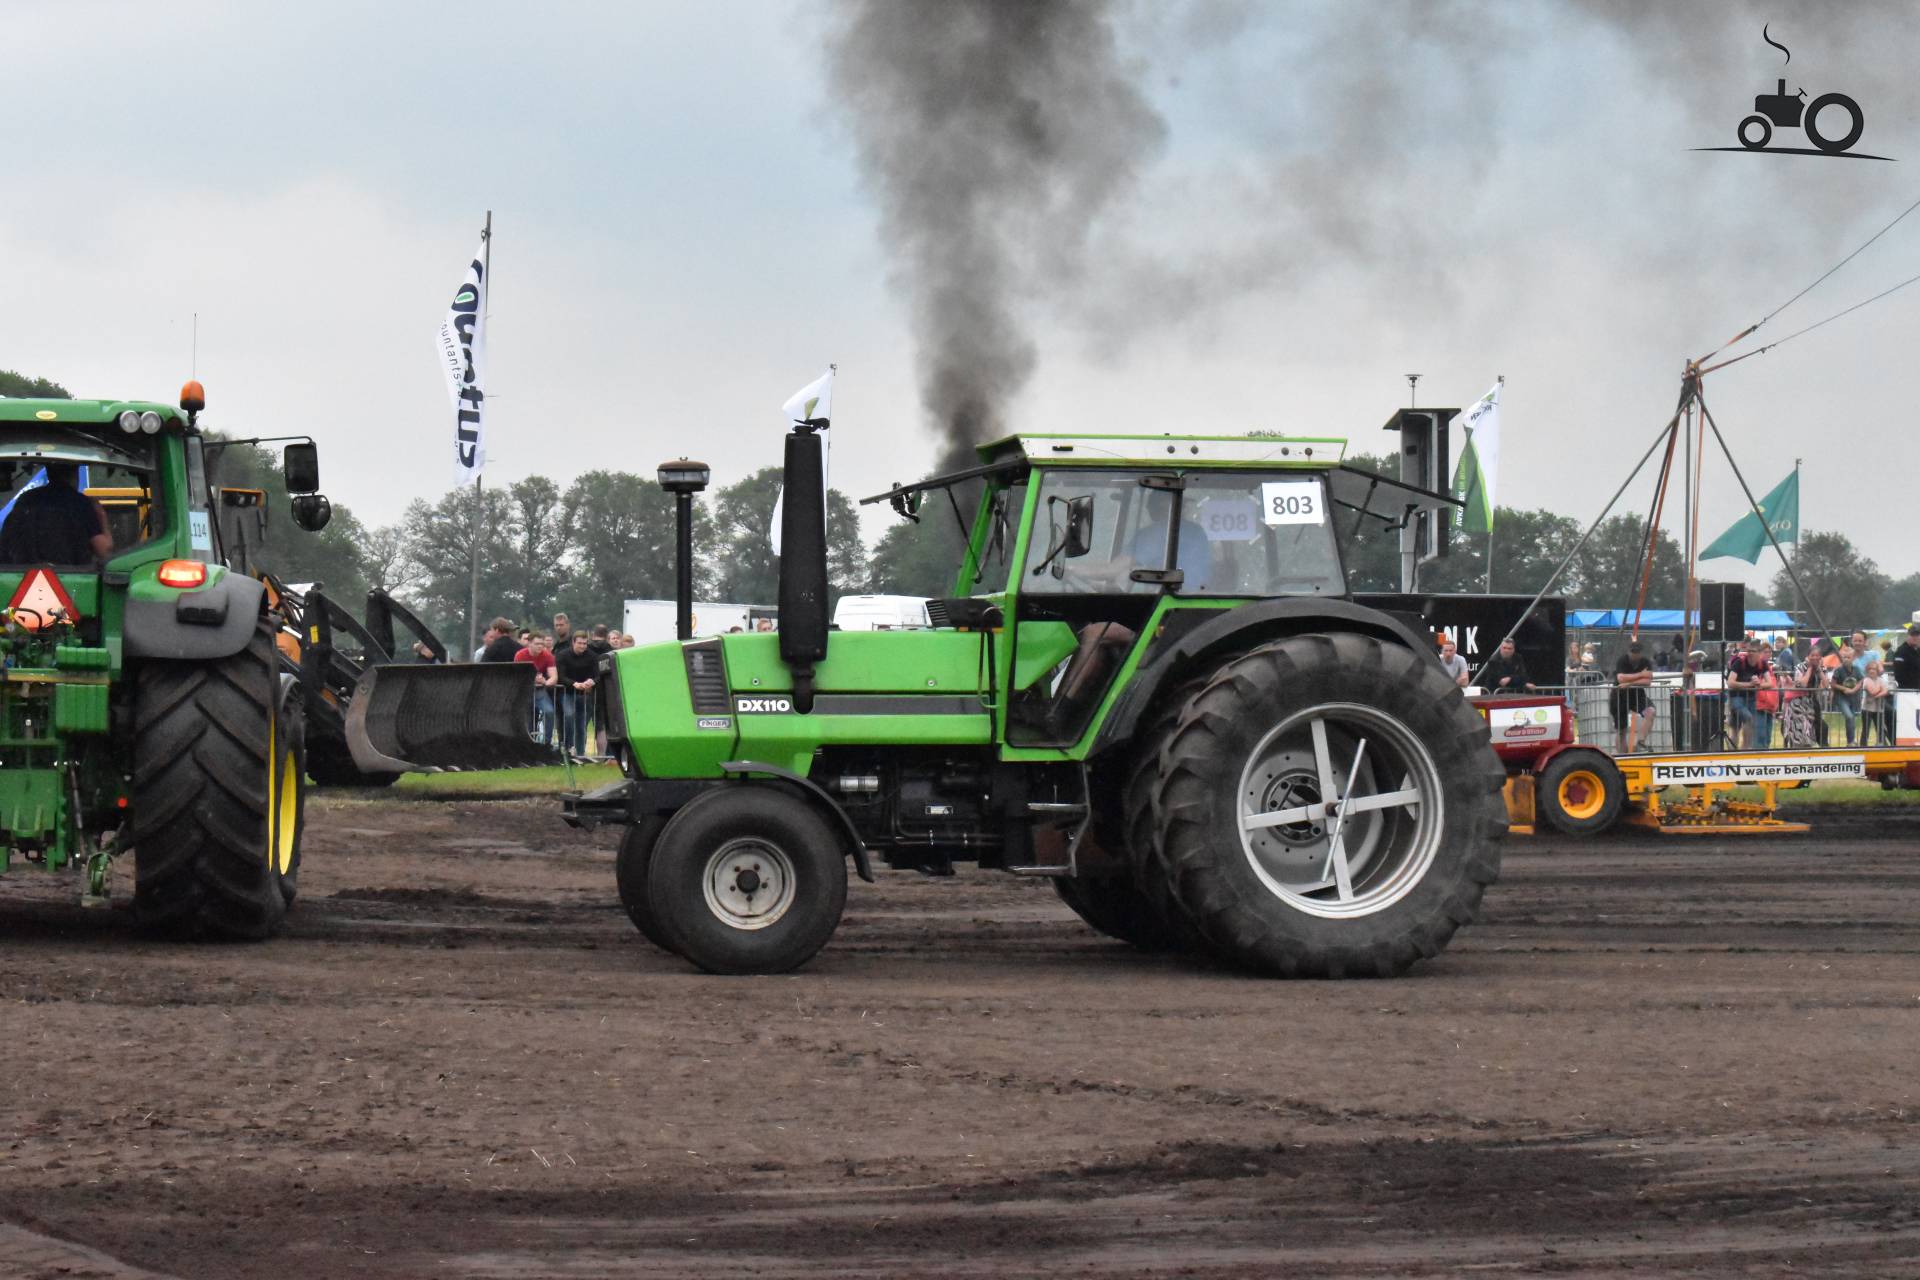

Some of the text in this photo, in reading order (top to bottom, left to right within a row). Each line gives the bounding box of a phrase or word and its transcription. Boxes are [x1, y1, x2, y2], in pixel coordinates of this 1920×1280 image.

[1273, 495, 1314, 515] 803
[738, 699, 790, 712] DX110
[1657, 763, 1861, 779] REMON water behandeling
